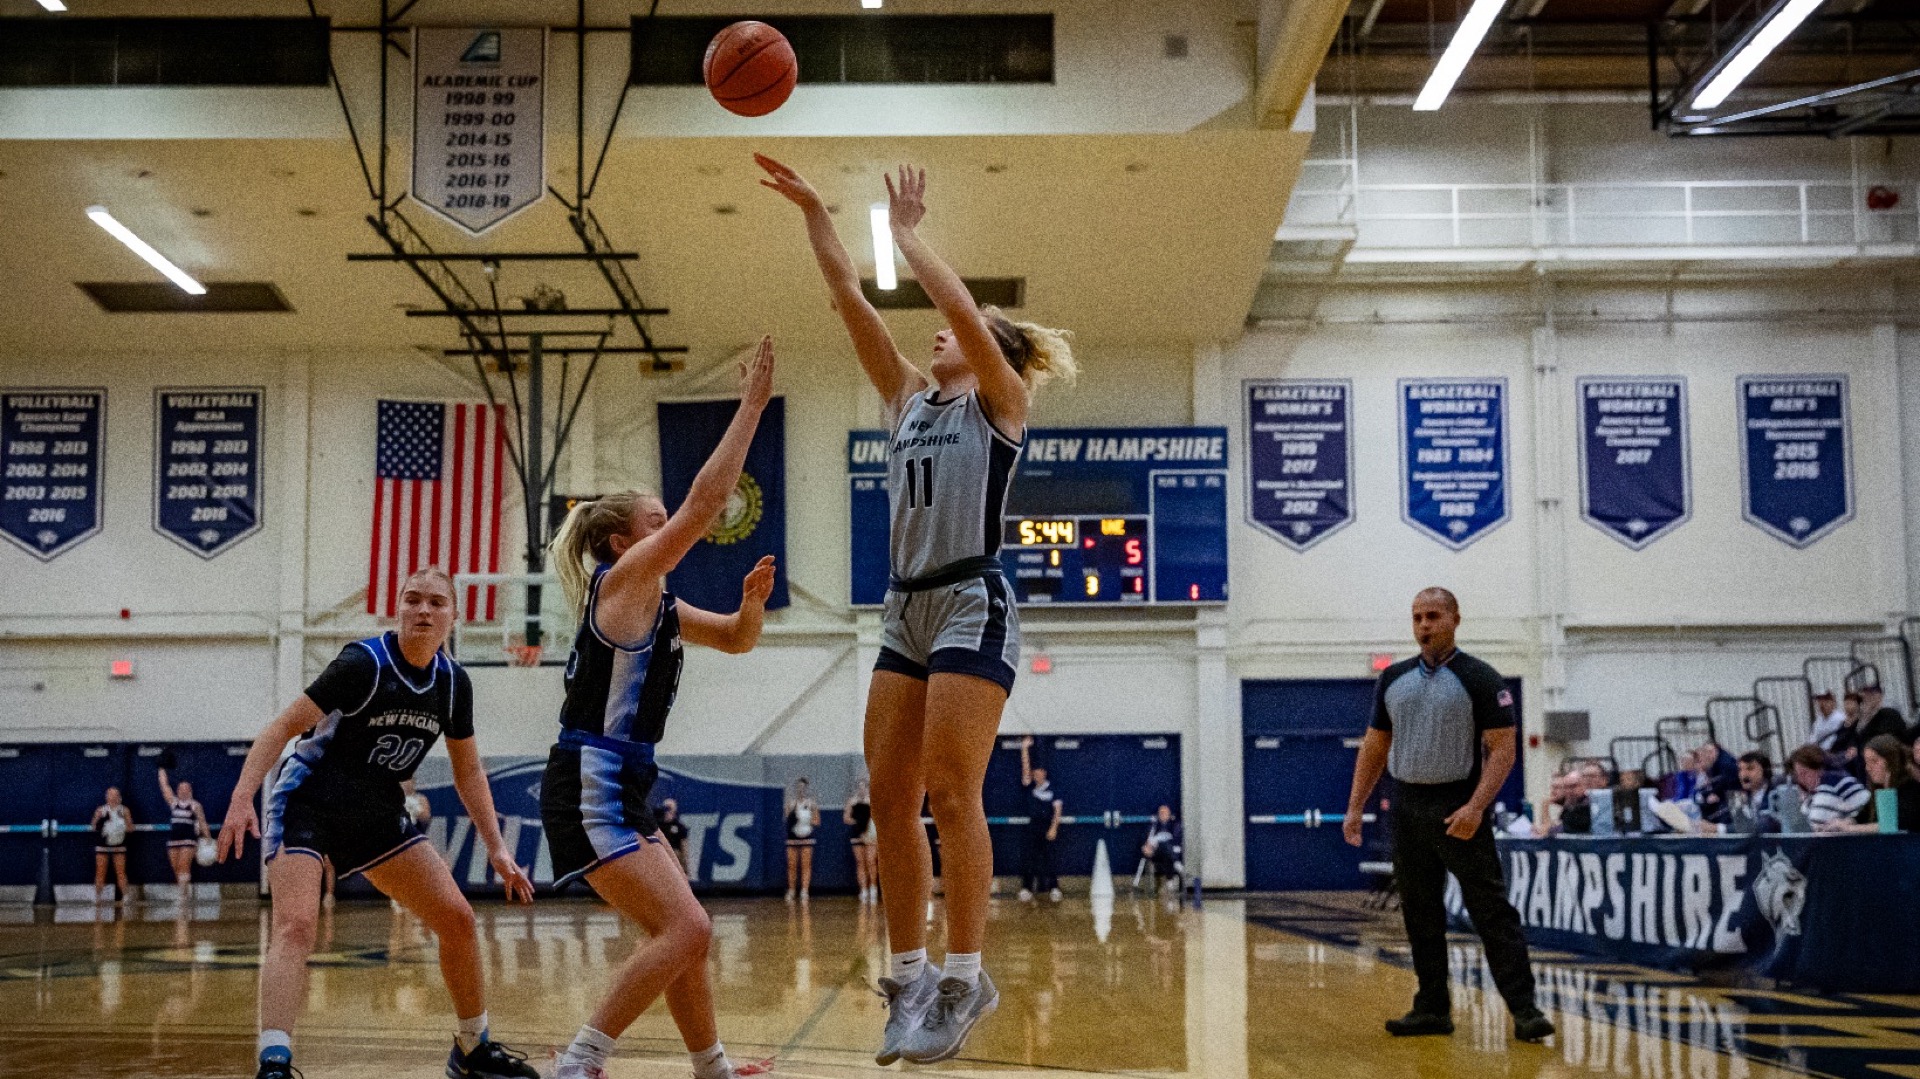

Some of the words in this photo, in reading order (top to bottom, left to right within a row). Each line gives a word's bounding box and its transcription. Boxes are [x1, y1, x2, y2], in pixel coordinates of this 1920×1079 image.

[423, 76, 502, 88] ACADEMIC
[507, 76, 539, 88] CUP
[445, 113, 515, 126] 1999-00
[446, 133, 511, 146] 2014-15
[446, 153, 511, 167] 2015-16
[446, 174, 511, 188] 2016-17
[1254, 387, 1342, 400] BASKETBALL
[1409, 386, 1496, 399] BASKETBALL
[1587, 385, 1675, 398] BASKETBALL
[1748, 384, 1837, 397] BASKETBALL
[9, 396, 95, 409] VOLLEYBALL
[168, 395, 253, 408] VOLLEYBALL
[1264, 402, 1332, 415] WOMEN'S
[1420, 400, 1488, 413] WOMEN'S
[1598, 399, 1667, 413] WOMEN'S
[1027, 438, 1083, 462] NEW
[1085, 437, 1224, 462] HAMPSHIRE
[1773, 442, 1819, 460] 2015
[6, 463, 47, 477] 2002
[50, 463, 88, 477] 2014
[167, 462, 208, 476] 2002
[212, 462, 248, 476] 2014
[905, 455, 934, 509] 11
[5, 486, 46, 500] 2003
[167, 485, 207, 499] 2003
[1019, 520, 1074, 545] 5:44
[1050, 549, 1060, 566] 1
[1125, 539, 1142, 564] 5
[1086, 575, 1099, 596] 3
[368, 714, 399, 727] NEW
[367, 734, 424, 771] 20
[1508, 850, 1748, 954] HAMPSHIRE
